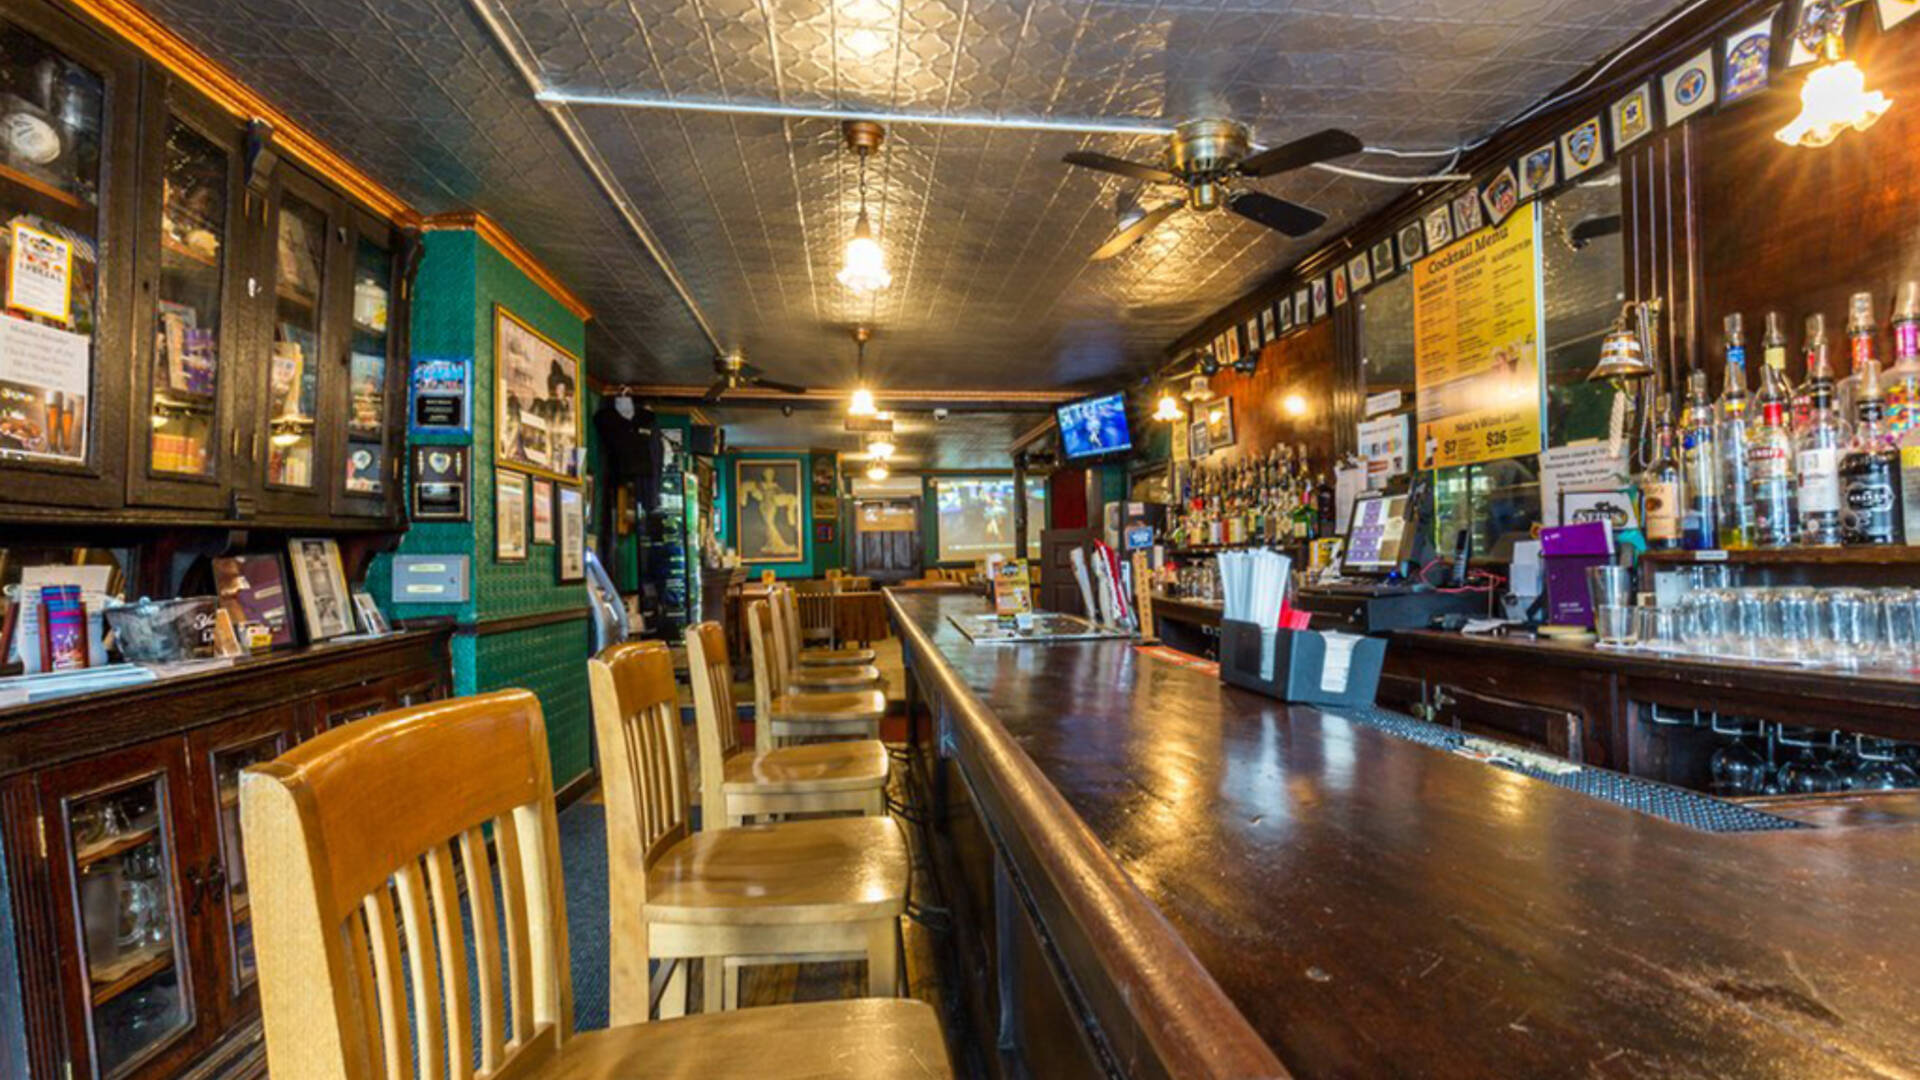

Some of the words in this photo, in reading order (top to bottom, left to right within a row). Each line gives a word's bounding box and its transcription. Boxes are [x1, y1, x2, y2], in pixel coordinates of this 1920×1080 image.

[1428, 242, 1473, 274] Cocktail
[1475, 227, 1509, 252] Menu
[1444, 440, 1456, 455] $7
[1486, 430, 1507, 448] $26
